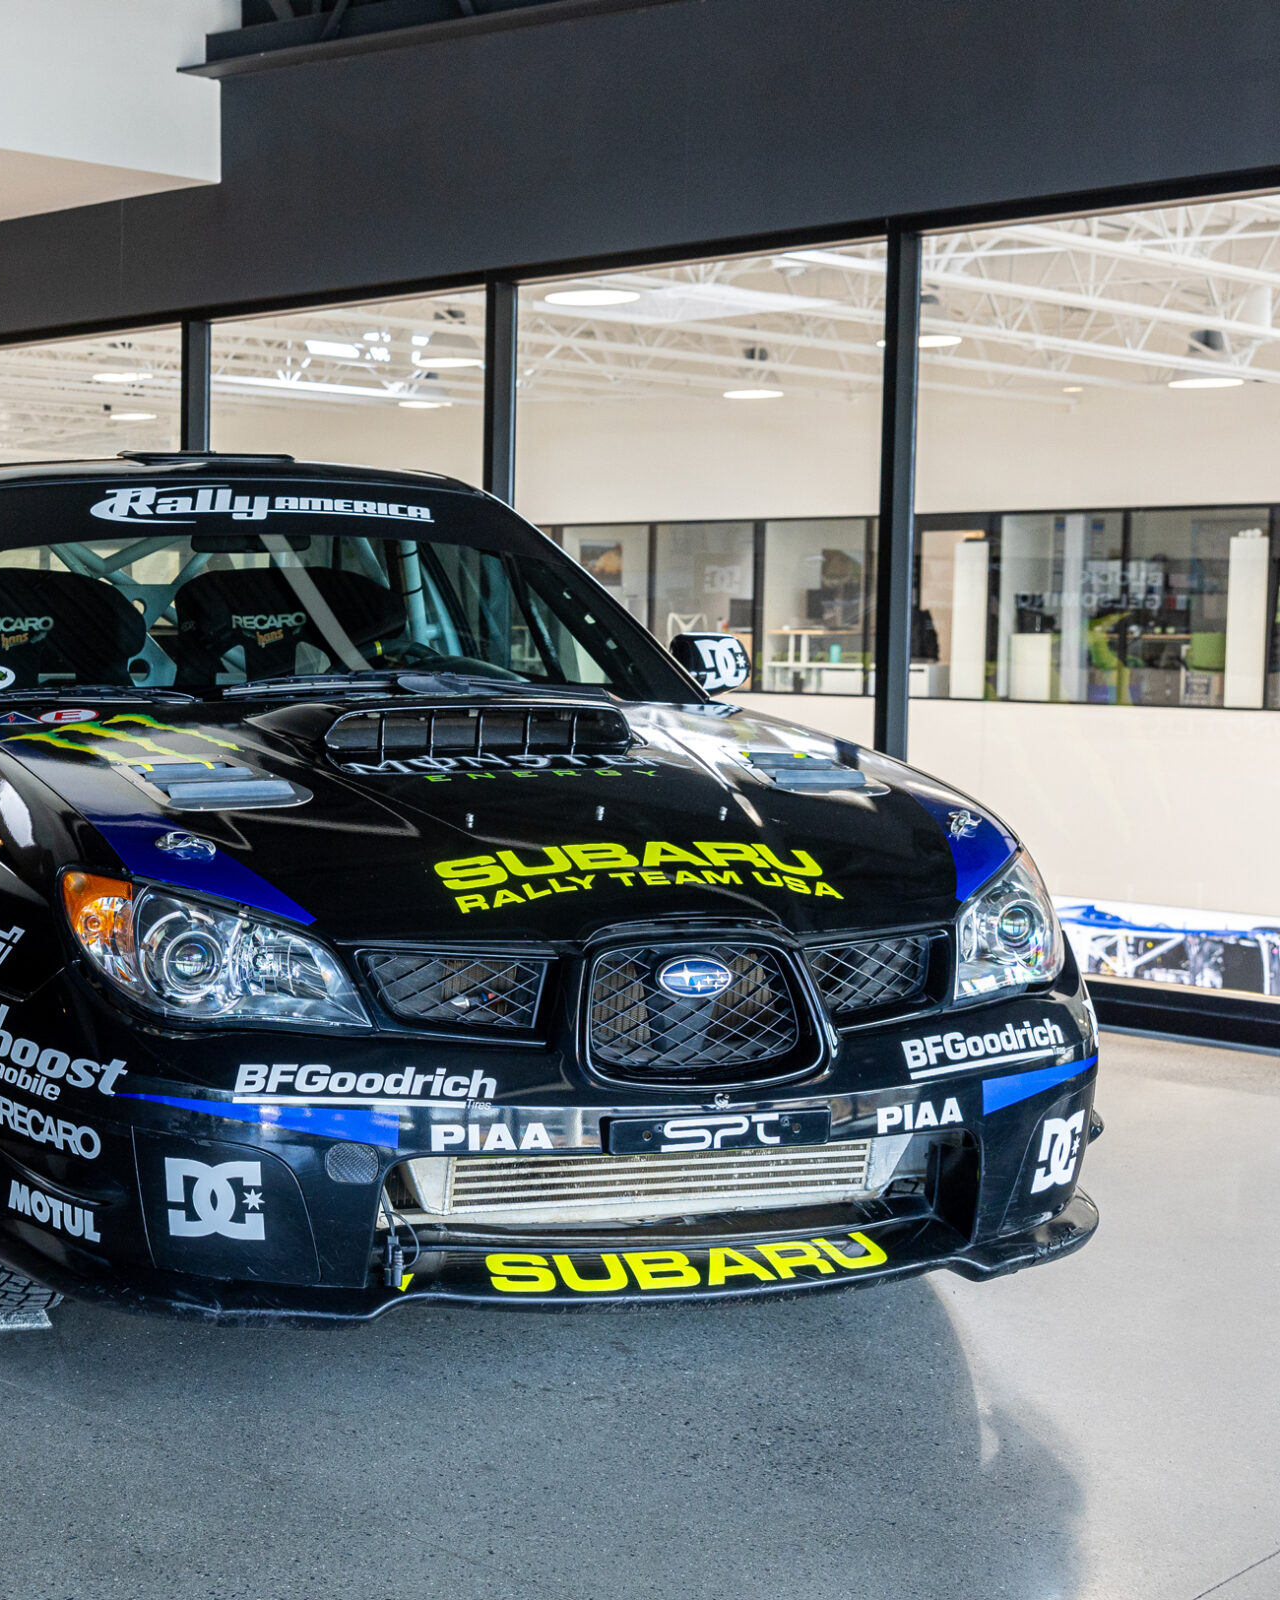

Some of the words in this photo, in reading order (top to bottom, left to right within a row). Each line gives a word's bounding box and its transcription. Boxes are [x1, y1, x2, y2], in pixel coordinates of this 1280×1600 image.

[92, 485, 269, 522] Rally
[232, 611, 307, 630] RECARO
[425, 769, 658, 782] ENERGY
[434, 841, 824, 890] SUBARU
[455, 873, 596, 914] RALLY
[609, 870, 744, 887] TEAM
[752, 871, 845, 900] USA
[901, 1018, 1065, 1069] BFGoodrich
[234, 1064, 497, 1099] BFGoodrich
[466, 1098, 492, 1111] Tires
[877, 1097, 963, 1134] PIAA
[431, 1123, 554, 1151] PIAA
[8, 1179, 101, 1243] MOTUL
[485, 1231, 888, 1292] SUBARU
